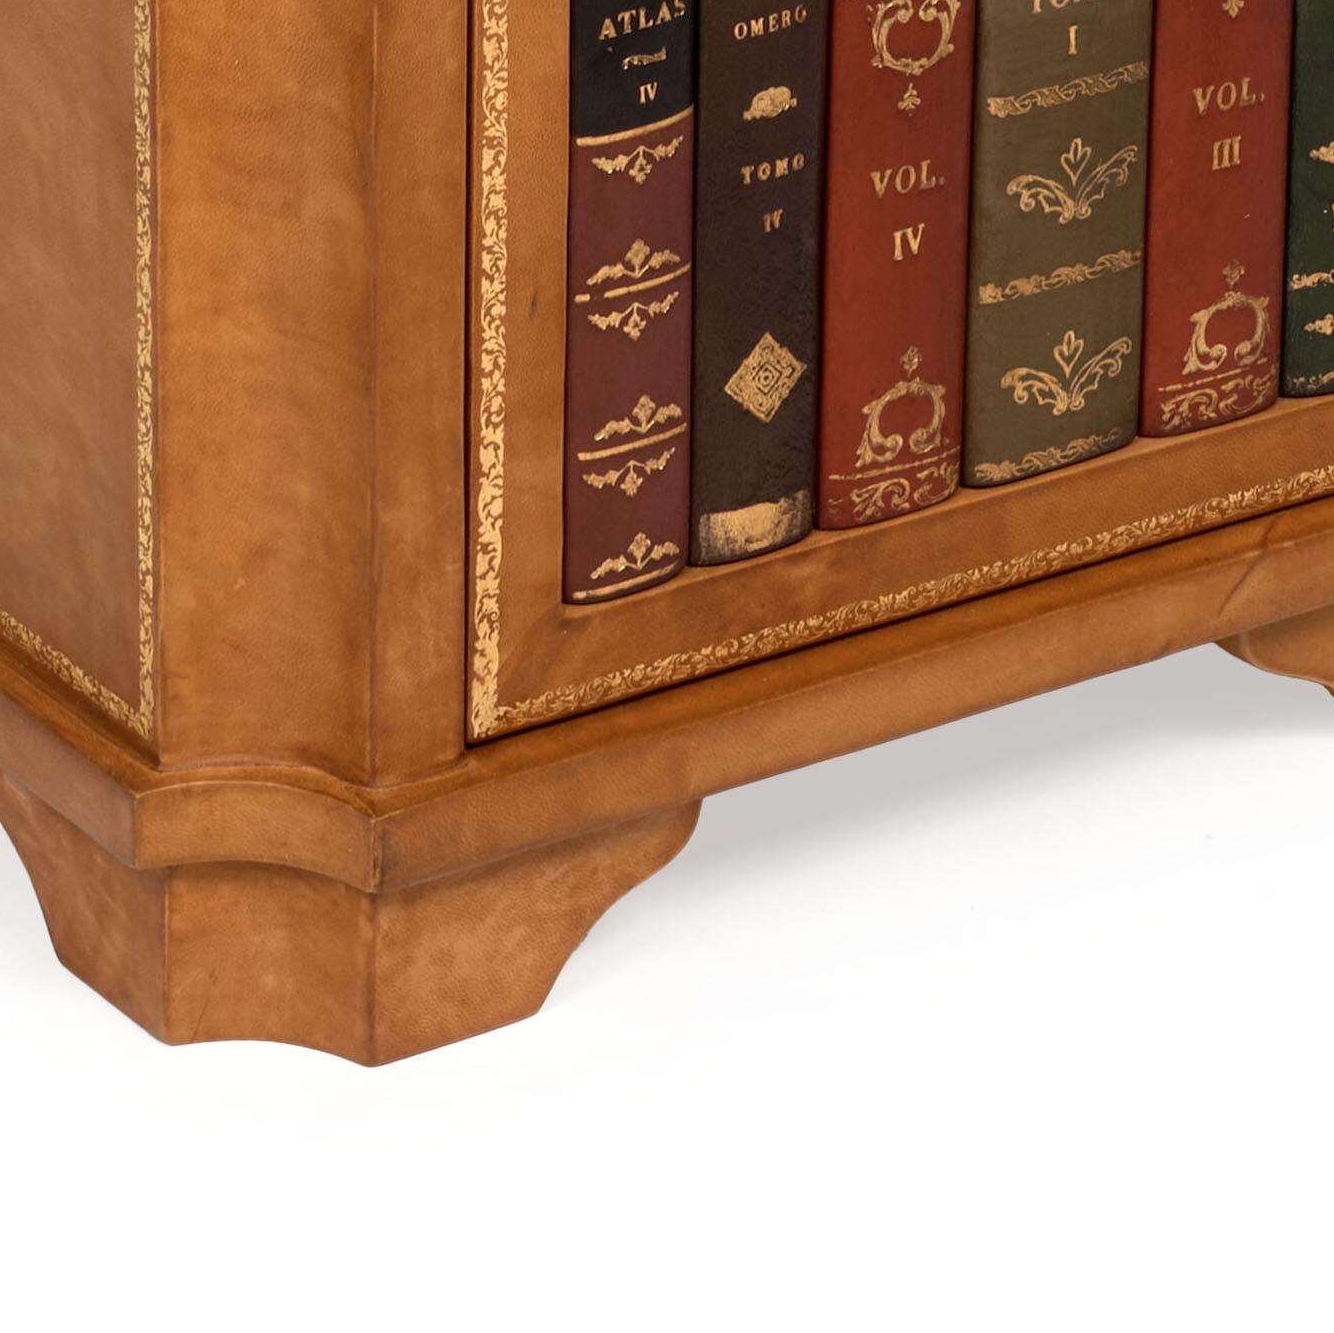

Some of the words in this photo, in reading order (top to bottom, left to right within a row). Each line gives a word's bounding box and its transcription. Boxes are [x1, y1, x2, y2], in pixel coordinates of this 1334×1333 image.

[734, 4, 806, 39] OMERO
[1067, 24, 1079, 56] I
[639, 82, 657, 104] IV
[1192, 77, 1266, 115] VOL.
[740, 153, 804, 184] TOMO
[1211, 135, 1241, 170] III
[870, 159, 945, 196] VOL.
[763, 208, 783, 233] IV
[892, 223, 925, 261] IV
